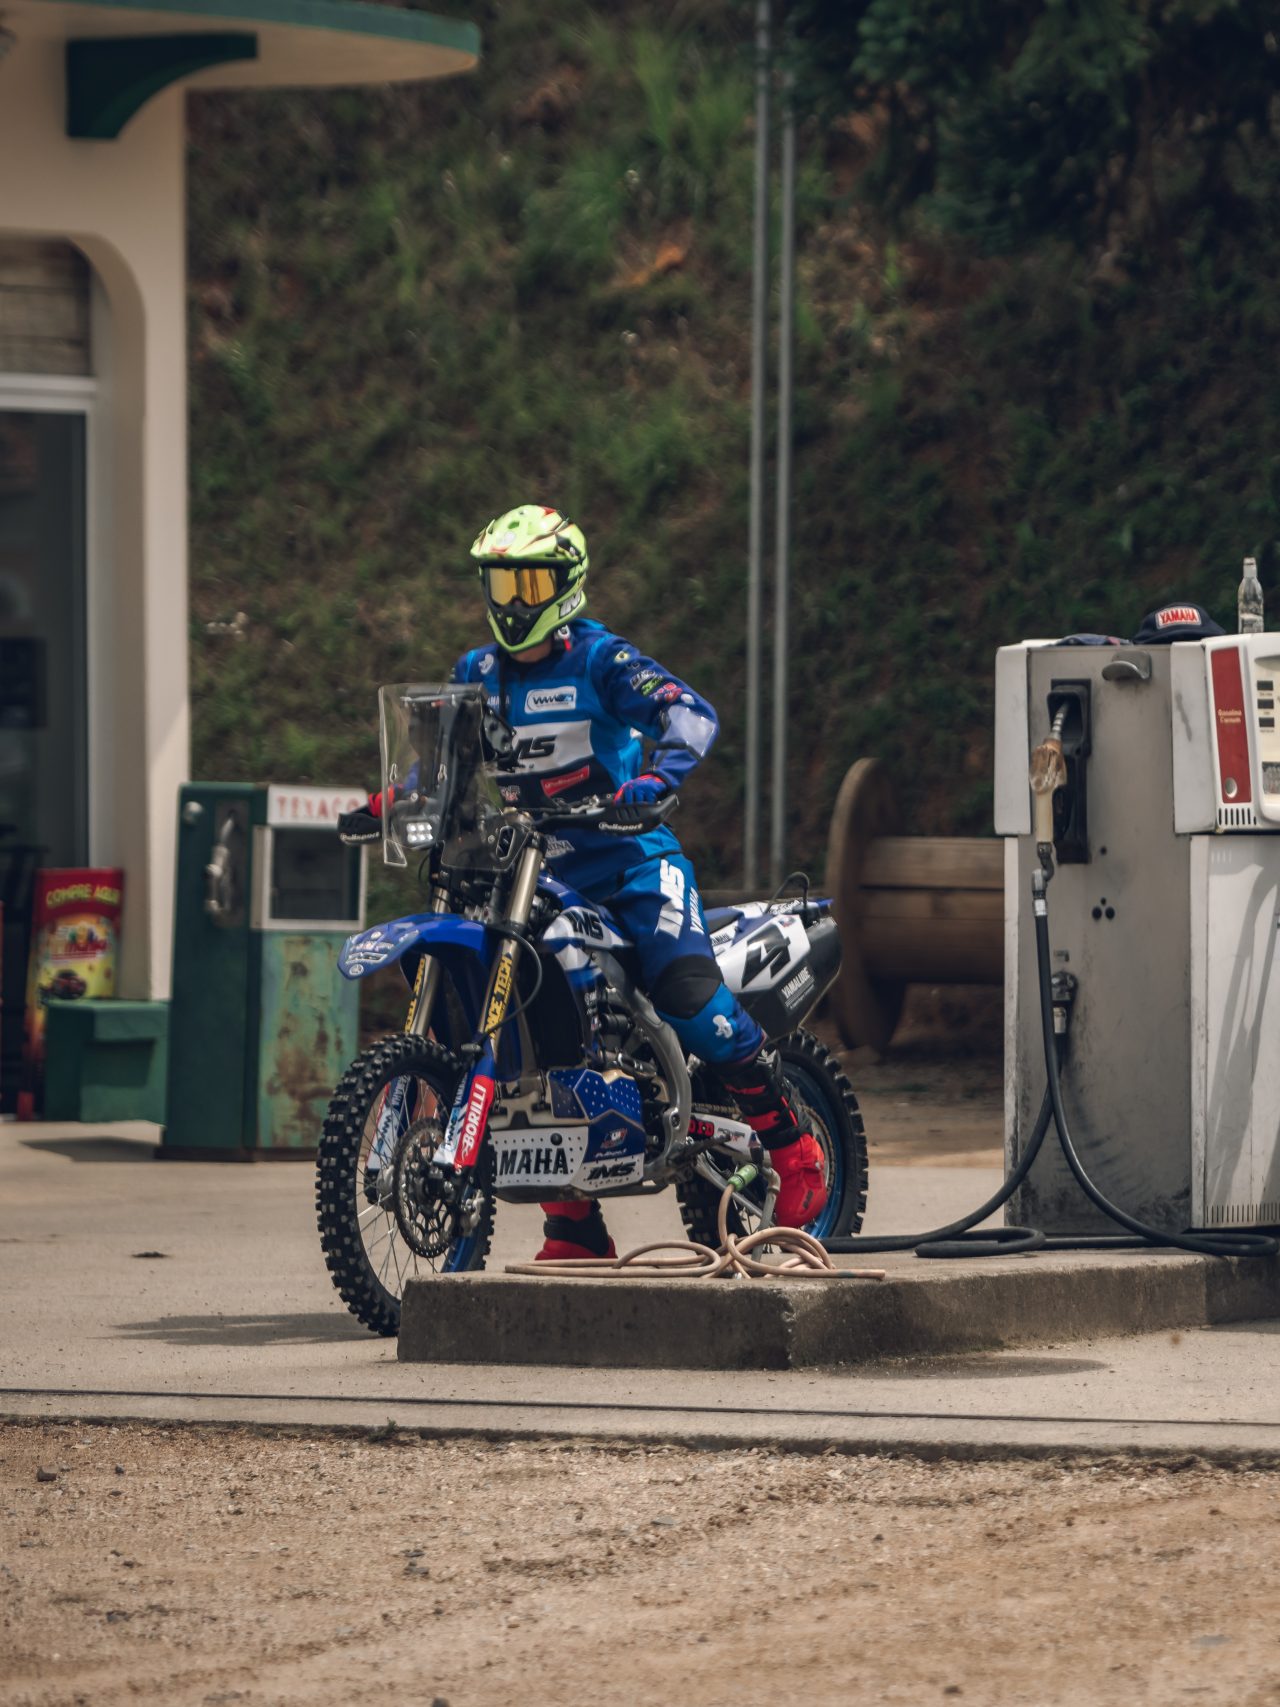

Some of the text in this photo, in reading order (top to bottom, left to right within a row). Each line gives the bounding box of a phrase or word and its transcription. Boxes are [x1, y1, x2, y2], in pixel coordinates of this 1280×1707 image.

[1160, 607, 1198, 624] YAMAHA
[598, 822, 643, 831] Polisport
[654, 858, 685, 940] IMS
[741, 923, 791, 989] 4
[494, 956, 513, 997] TECH
[781, 967, 812, 999] YAMALUBE
[462, 1082, 486, 1155] BORILLI
[586, 1161, 637, 1181] IMS
